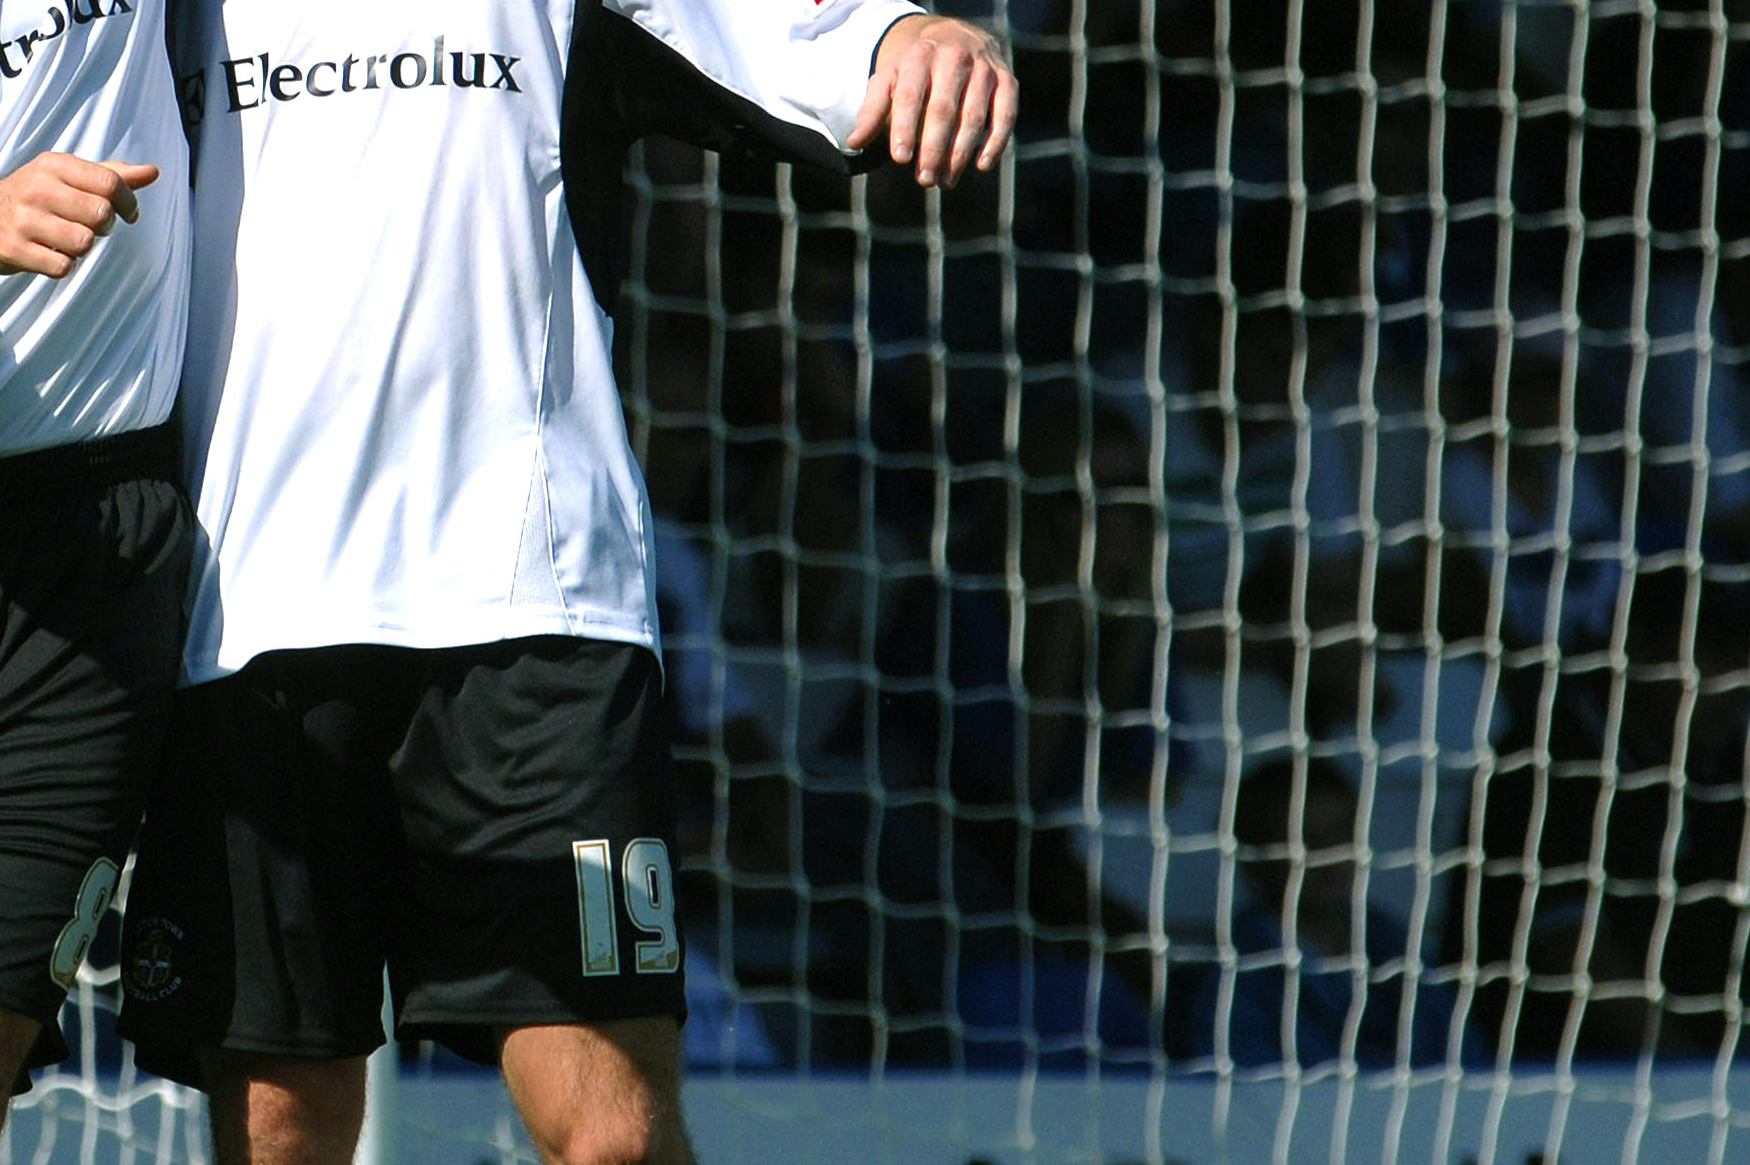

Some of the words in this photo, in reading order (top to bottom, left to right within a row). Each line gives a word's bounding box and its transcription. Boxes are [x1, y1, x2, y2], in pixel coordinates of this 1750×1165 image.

[219, 34, 523, 114] Electrolux
[51, 856, 119, 992] 8
[572, 837, 680, 977] 19
